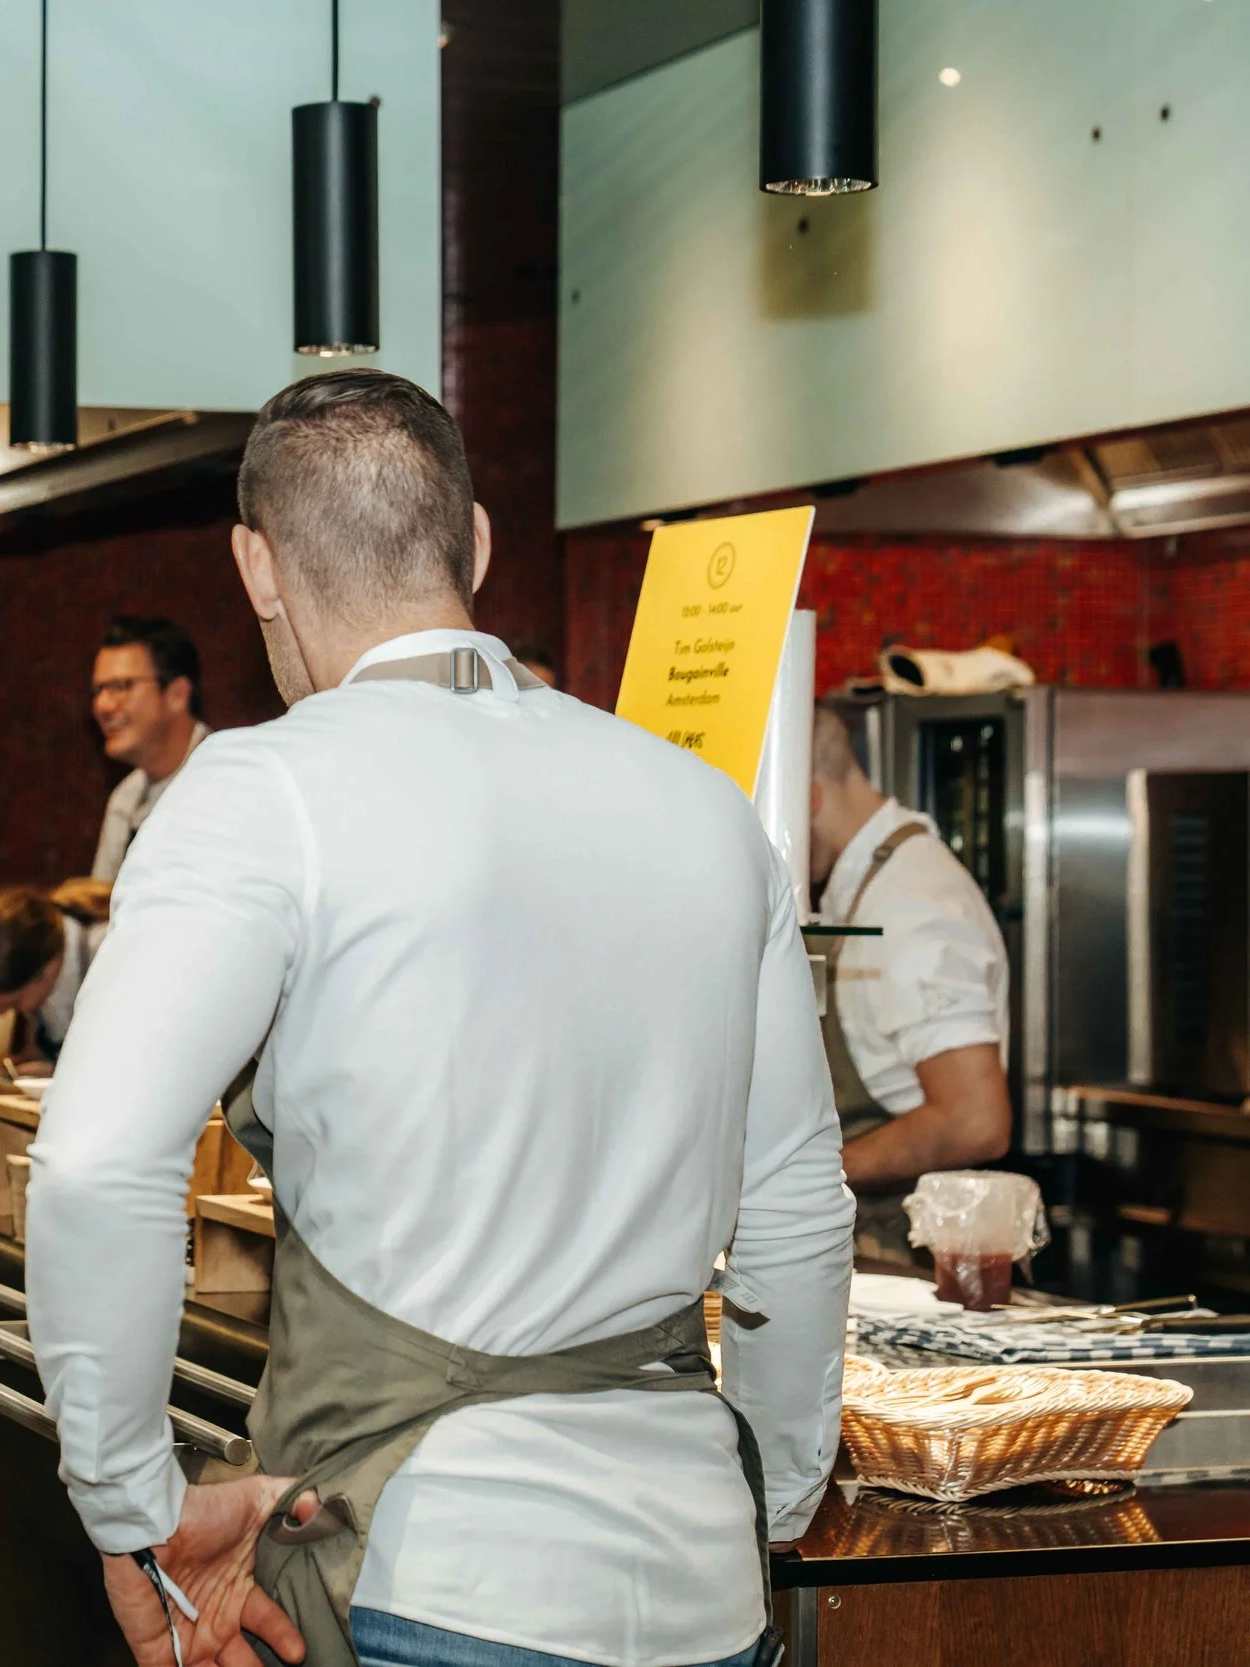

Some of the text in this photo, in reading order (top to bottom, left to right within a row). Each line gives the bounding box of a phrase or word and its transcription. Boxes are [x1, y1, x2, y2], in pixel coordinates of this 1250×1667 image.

[674, 639, 691, 655] Tim
[668, 661, 729, 684] Bougainville
[665, 689, 721, 707] Amsterdam
